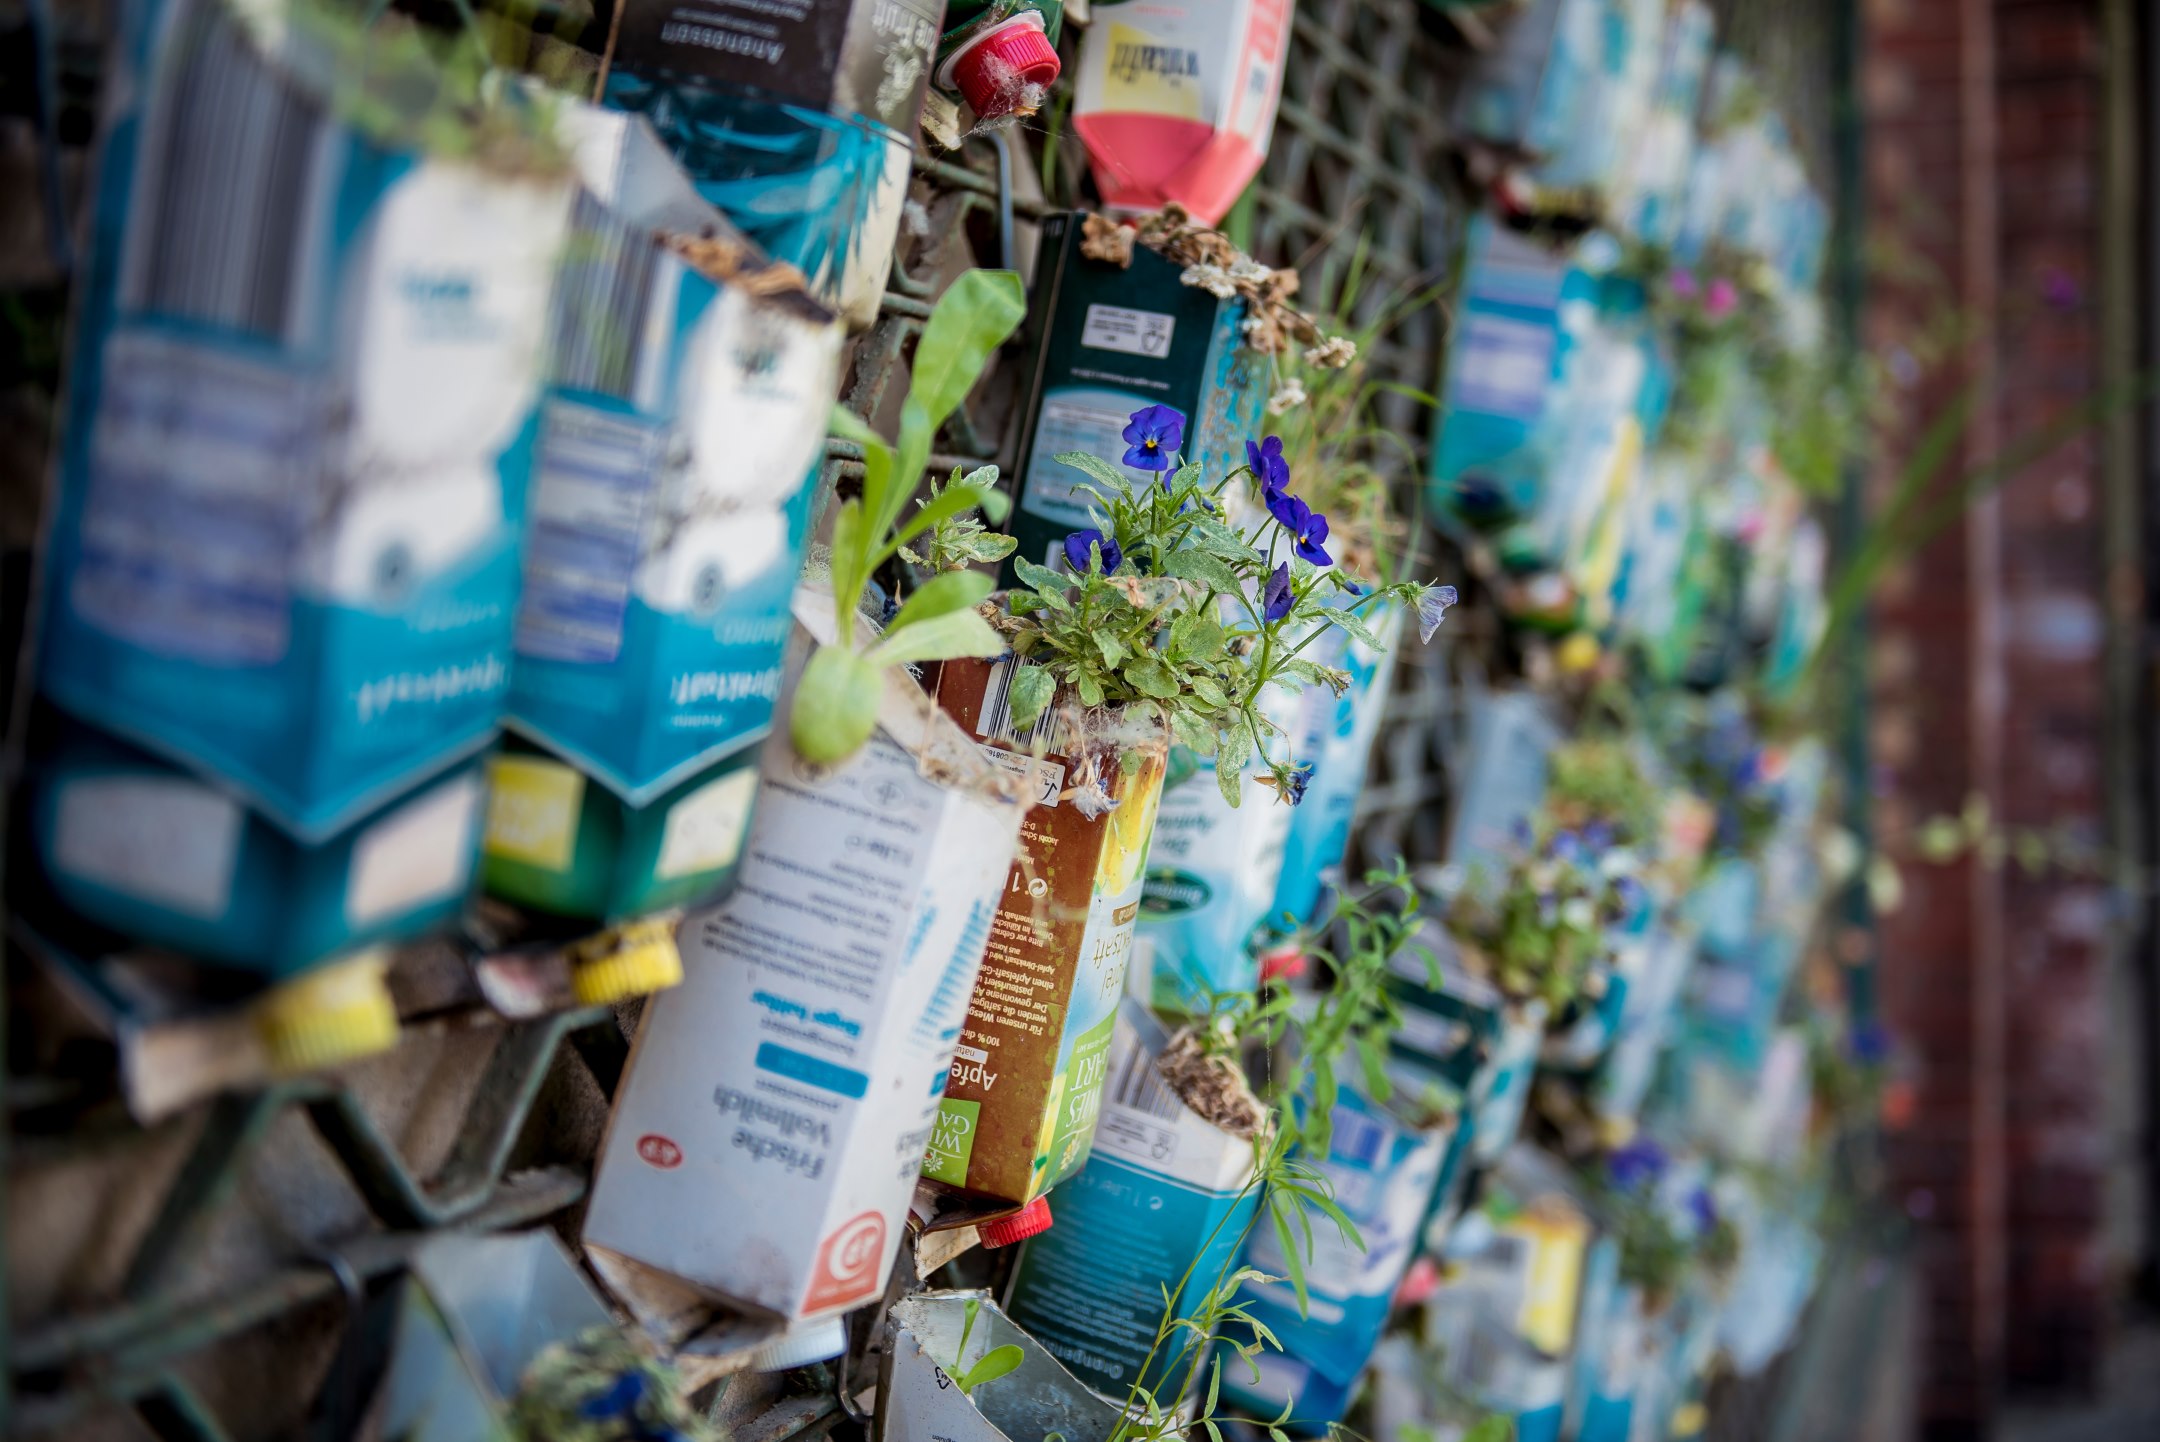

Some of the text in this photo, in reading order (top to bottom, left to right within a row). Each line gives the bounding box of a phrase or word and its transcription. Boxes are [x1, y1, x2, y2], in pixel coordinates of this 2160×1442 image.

[660, 21, 785, 65] Ananassaft
[1038, 834, 1059, 846] Jacobi
[1004, 911, 1034, 926] innerhalb
[1035, 919, 1048, 929] und
[1022, 926, 1031, 935] im
[1028, 936, 1044, 948] Bitte
[1008, 947, 1021, 956] aus
[988, 951, 1056, 975] Apfel-Direktsaft wird
[983, 978, 1034, 997] pasteurisiert
[1032, 978, 1054, 990] einen
[986, 989, 1032, 1009] gewonnene
[970, 997, 1047, 1024] werden die saftigen
[1033, 1002, 1048, 1014] Der
[996, 1015, 1028, 1031] unseren
[1029, 1024, 1043, 1036] Für
[712, 1084, 831, 1149] Vollmilch
[933, 1109, 970, 1136] GA
[927, 1126, 961, 1155] WI
[730, 1129, 826, 1181] Frische
[1038, 1338, 1125, 1381] Orangens
